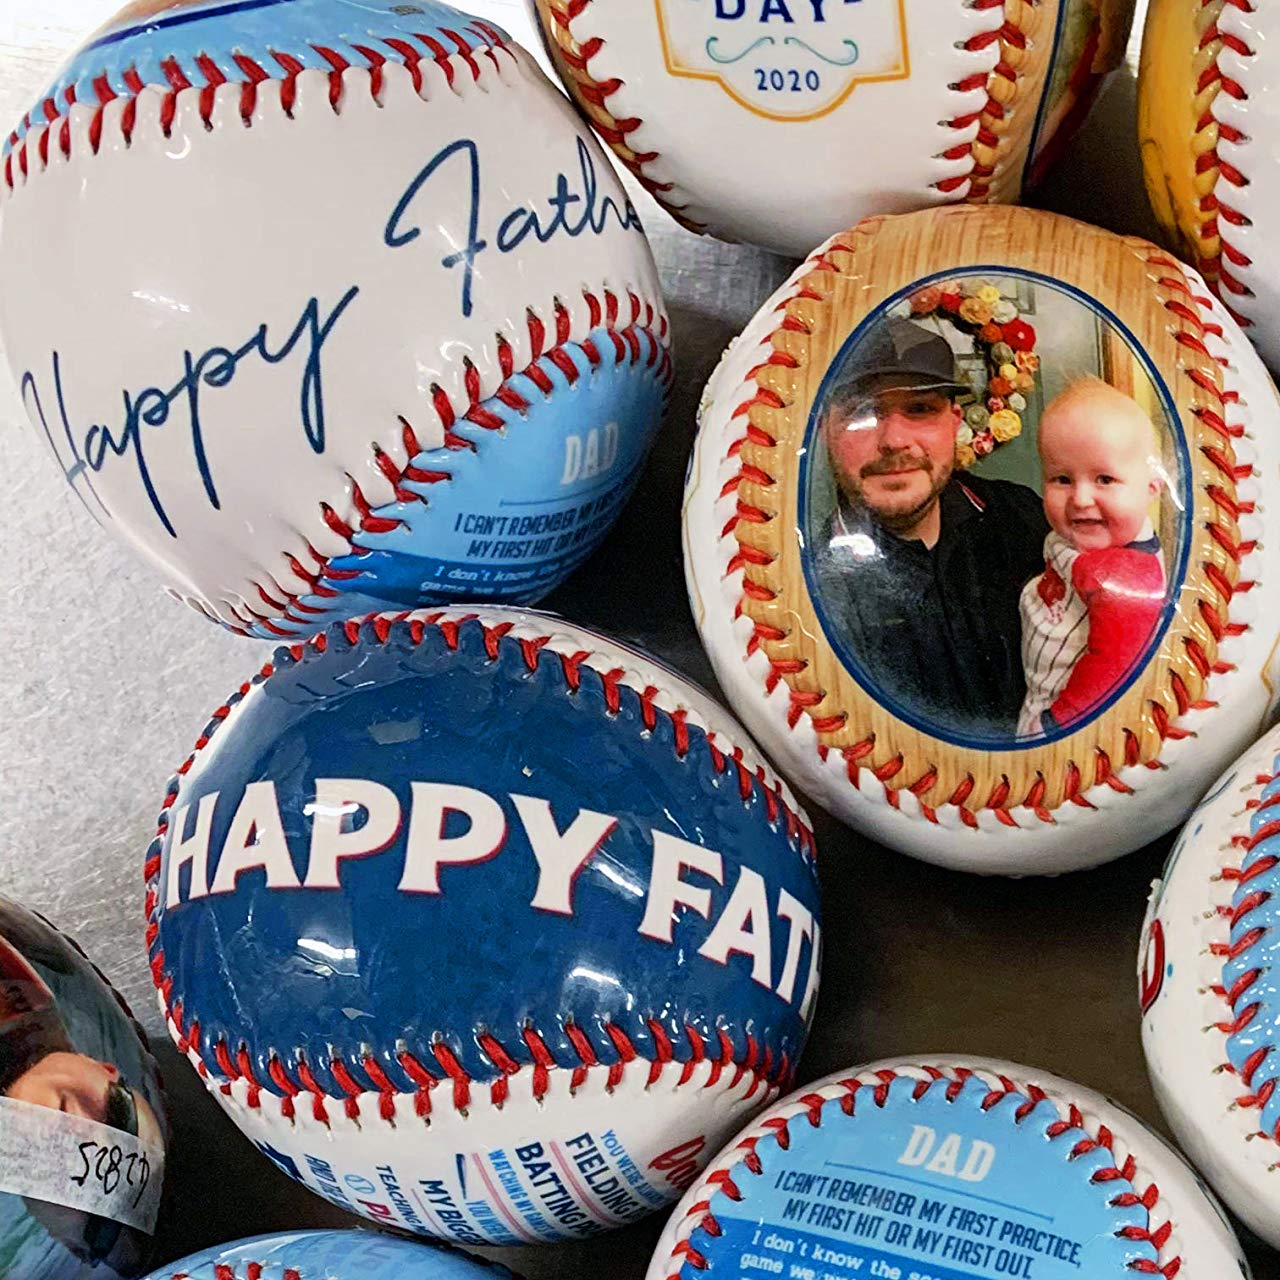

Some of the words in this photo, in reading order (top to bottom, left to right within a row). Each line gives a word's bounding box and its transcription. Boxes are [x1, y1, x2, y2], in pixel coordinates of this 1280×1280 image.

[754, 68, 821, 92] 2020
[20, 285, 360, 539] Happy
[561, 422, 619, 486] DAD
[166, 777, 618, 916] HAPPY
[565, 1131, 631, 1219] FIELDING
[600, 1129, 624, 1157] YOU
[898, 1125, 996, 1182] DAD
[375, 1165, 424, 1231] TEACHING
[419, 1180, 456, 1208] MY
[488, 1149, 528, 1202] WATCHING
[515, 1141, 588, 1230] BATTING
[775, 1170, 786, 1188] I
[782, 1171, 829, 1197] CAN'T
[829, 1178, 916, 1217] REMEMBER
[919, 1198, 948, 1224] MY
[950, 1206, 997, 1238] FIRST
[999, 1219, 1083, 1270] PRACTICE,
[783, 1198, 807, 1222] MY
[807, 1203, 855, 1233] FIRST
[855, 1212, 882, 1238] HIT
[885, 1218, 911, 1248] OR
[913, 1227, 942, 1256] MY
[942, 1234, 993, 1268] FIRST
[739, 1252, 783, 1279] game
[790, 1264, 815, 1280] we
[751, 1229, 761, 1246] I
[763, 1233, 809, 1257] don't
[813, 1244, 863, 1271] know
[870, 1258, 902, 1280] the
